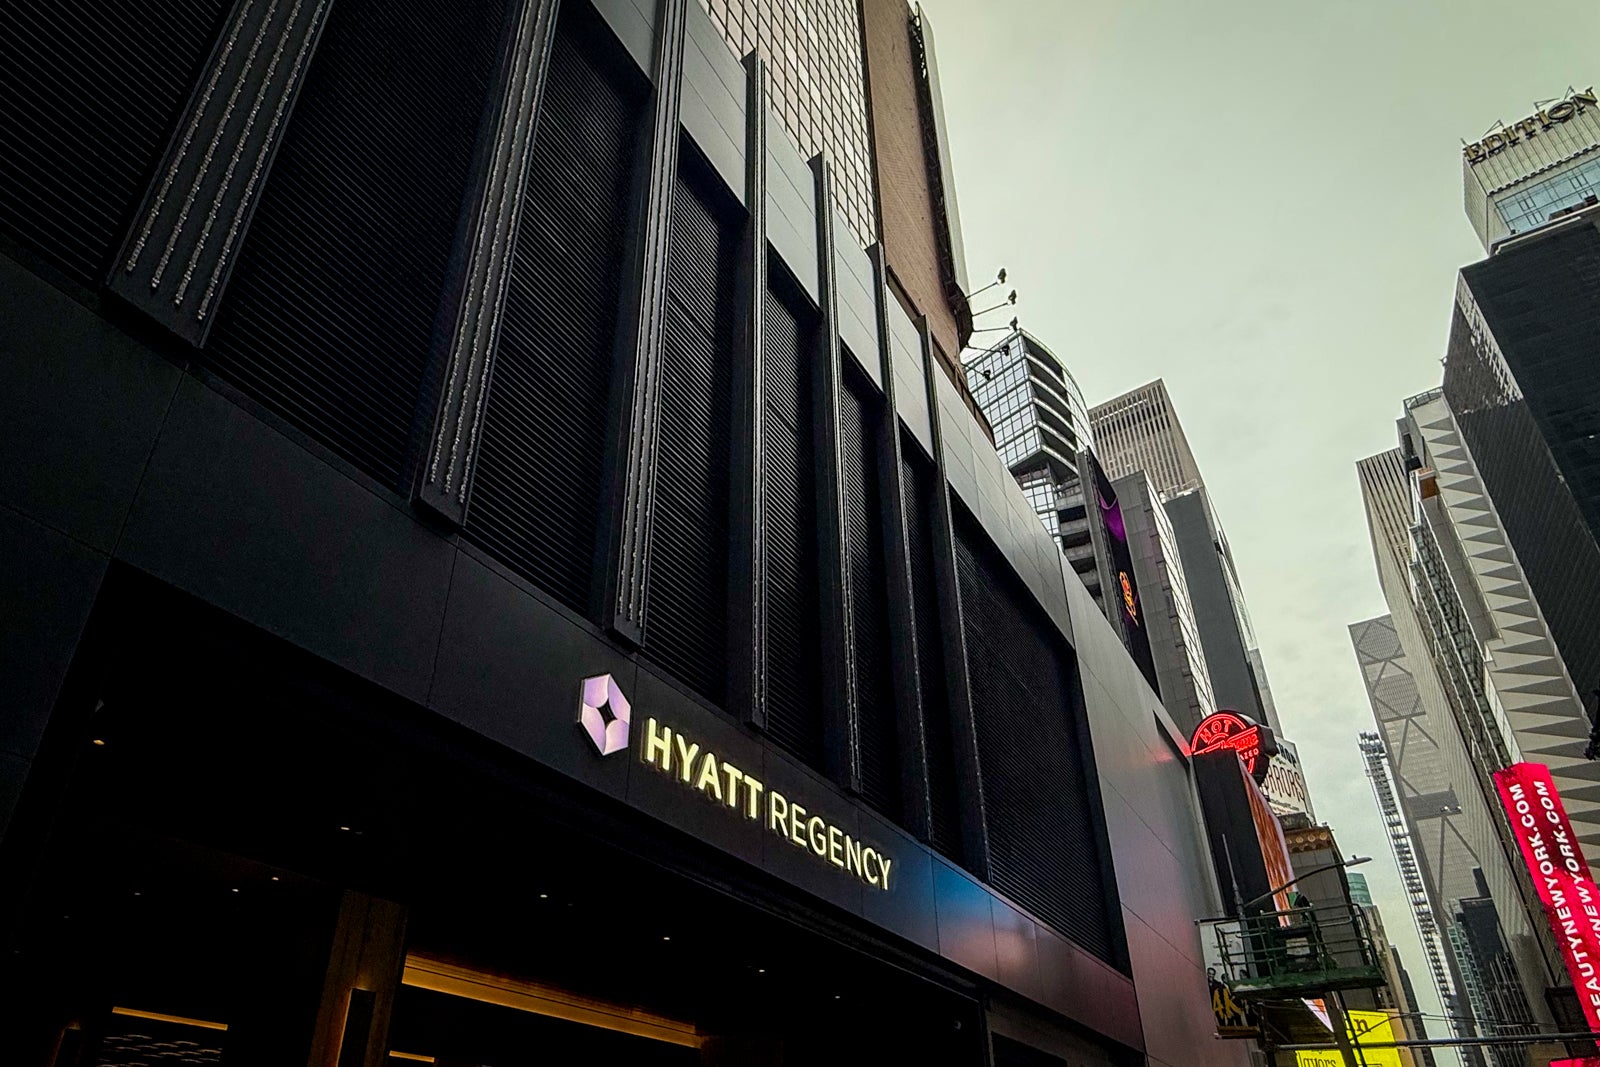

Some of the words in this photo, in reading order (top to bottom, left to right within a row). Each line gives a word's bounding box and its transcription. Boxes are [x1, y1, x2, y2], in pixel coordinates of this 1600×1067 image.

[1463, 86, 1598, 167] EDITION
[643, 717, 762, 820] HYATT
[767, 790, 891, 890] REGENCY
[1200, 719, 1232, 743] HOT
[1509, 783, 1600, 1021] EAUTYNEWYORK.COM
[1533, 781, 1600, 945] NEWYORK.COM
